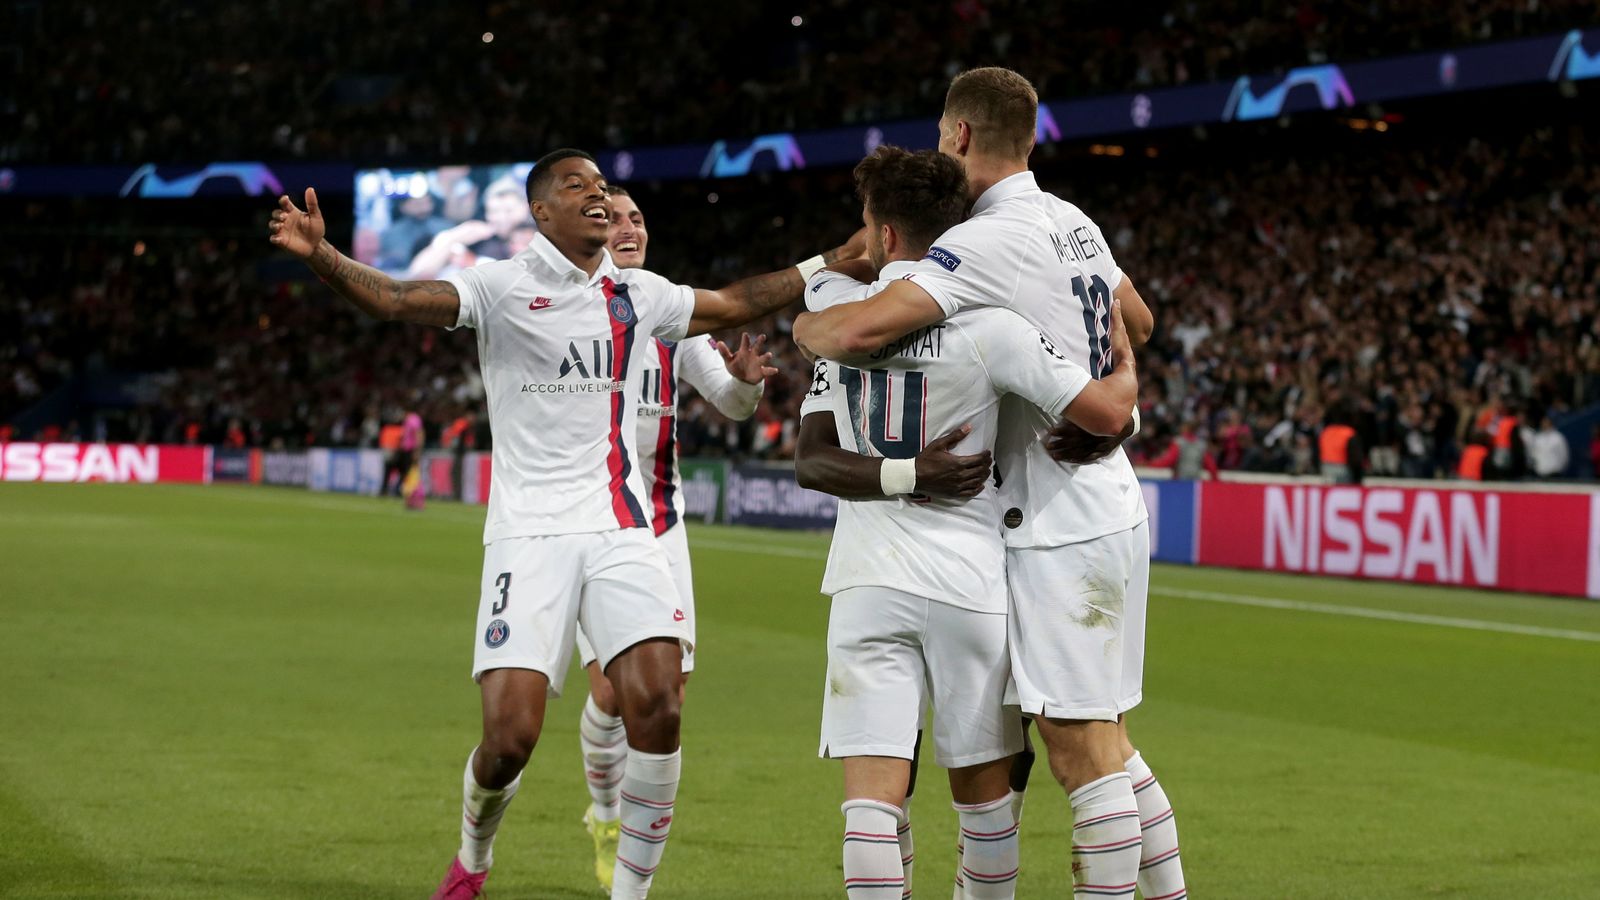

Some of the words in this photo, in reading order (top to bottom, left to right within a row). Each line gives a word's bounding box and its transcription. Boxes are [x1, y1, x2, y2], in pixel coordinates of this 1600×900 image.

[521, 383, 565, 393] ACCOR
[569, 383, 593, 392] LIVE
[839, 364, 927, 459] 14
[1263, 486, 1500, 586] NISSAN
[491, 571, 512, 616] 3
